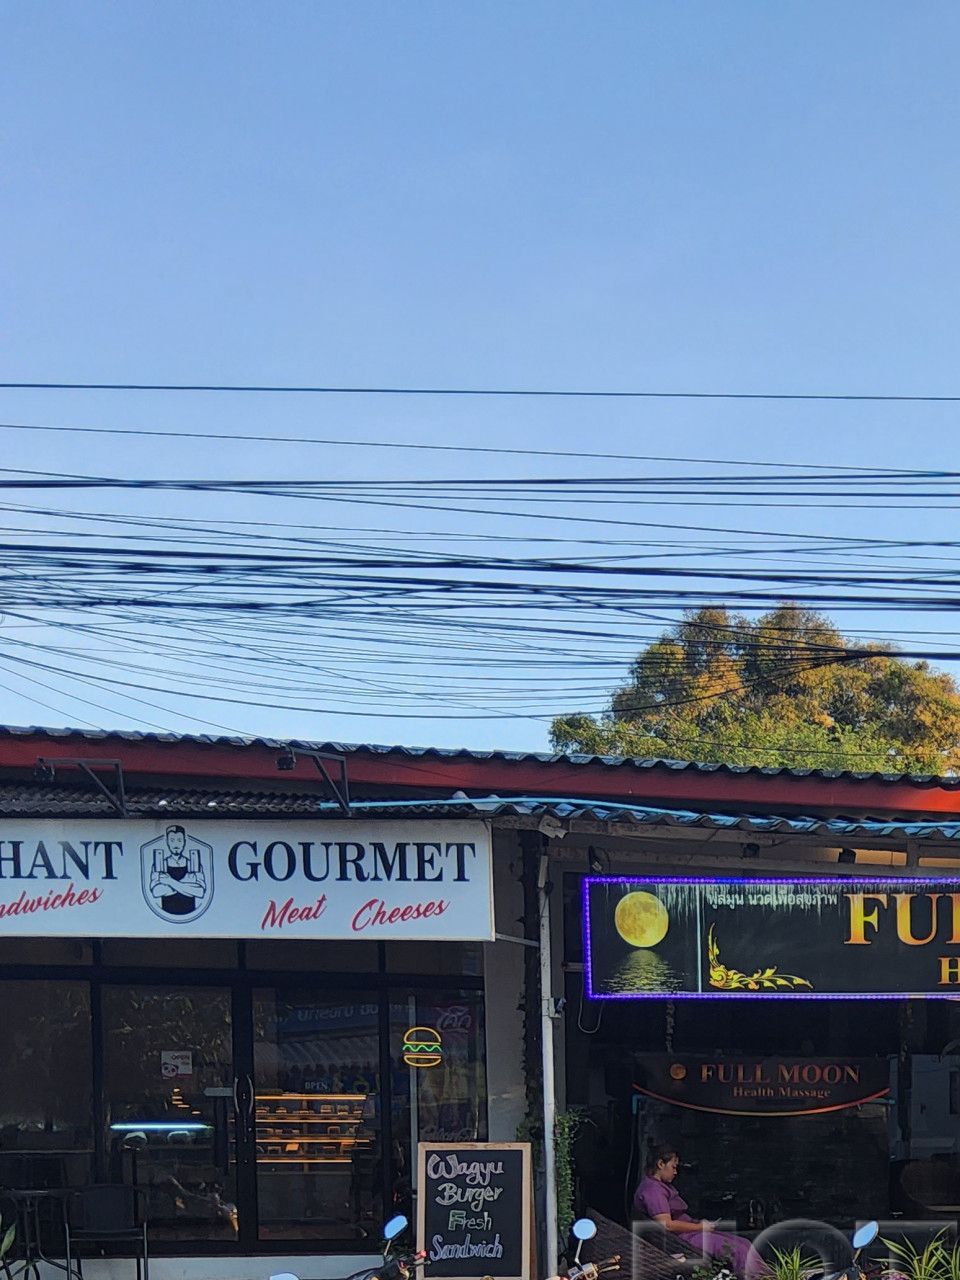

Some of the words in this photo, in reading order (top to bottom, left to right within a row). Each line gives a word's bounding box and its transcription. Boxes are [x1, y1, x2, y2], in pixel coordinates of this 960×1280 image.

[228, 840, 476, 882] GOURMET
[261, 893, 328, 931] Meat
[352, 898, 450, 932] Cheeses
[700, 1063, 772, 1084] FULL
[777, 1063, 860, 1084] MOON
[732, 1086, 775, 1098] Health
[778, 1086, 831, 1099] Massage
[427, 1153, 505, 1186] Wagyu
[435, 1182, 504, 1212] Burger
[448, 1209, 493, 1231] Fresh
[429, 1233, 504, 1262] Sandwich
